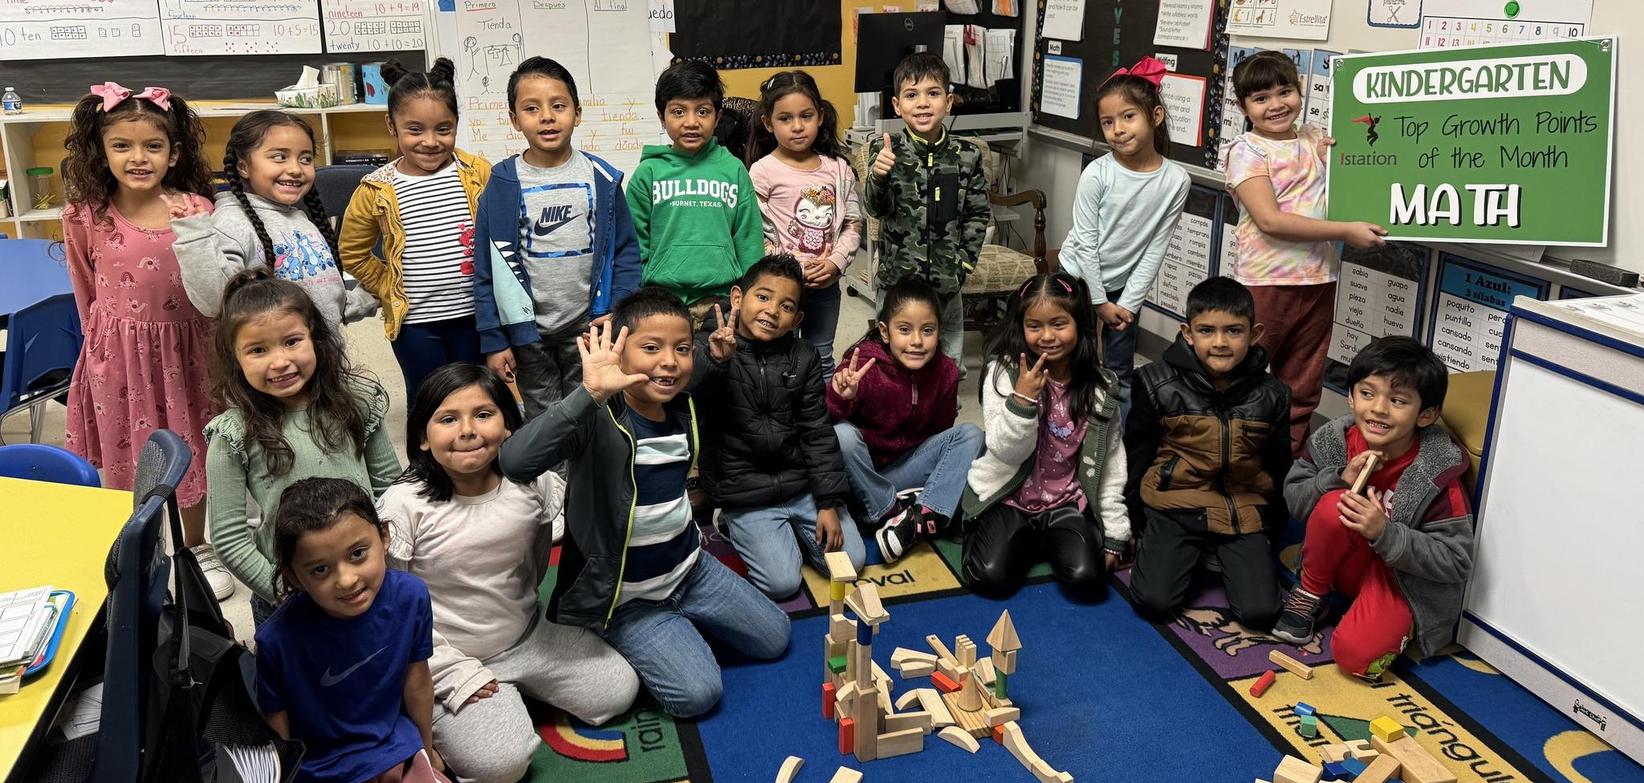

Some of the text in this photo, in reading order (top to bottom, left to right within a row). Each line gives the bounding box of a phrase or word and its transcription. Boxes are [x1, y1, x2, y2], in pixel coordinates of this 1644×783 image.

[327, 20, 350, 36] 20
[477, 17, 512, 31] Tienda
[21, 27, 42, 41] ten
[168, 25, 187, 44] 15
[1366, 60, 1571, 98] KINDERGARTEN
[1314, 83, 1324, 92] sa
[1310, 107, 1320, 116] se
[1394, 110, 1598, 144] Top Growth Points
[1340, 150, 1397, 166] Istation
[1418, 145, 1568, 169] of the Month
[652, 178, 739, 209] BULLDOGS
[1389, 183, 1522, 228] MATH
[540, 204, 572, 223] NIKE
[1350, 281, 1368, 292] suave
[1387, 279, 1408, 291] guapo
[1475, 275, 1512, 295] Azul:
[1348, 293, 1366, 304] pieza
[1387, 292, 1405, 303] agua
[1348, 306, 1363, 316] viejo
[1385, 305, 1404, 317] nadie
[1446, 299, 1475, 314] poquito
[1383, 315, 1403, 329] huevo
[1444, 313, 1472, 327] puntilla
[1441, 326, 1472, 342] cansado
[1437, 339, 1472, 357] cansando
[1485, 341, 1502, 352] sen
